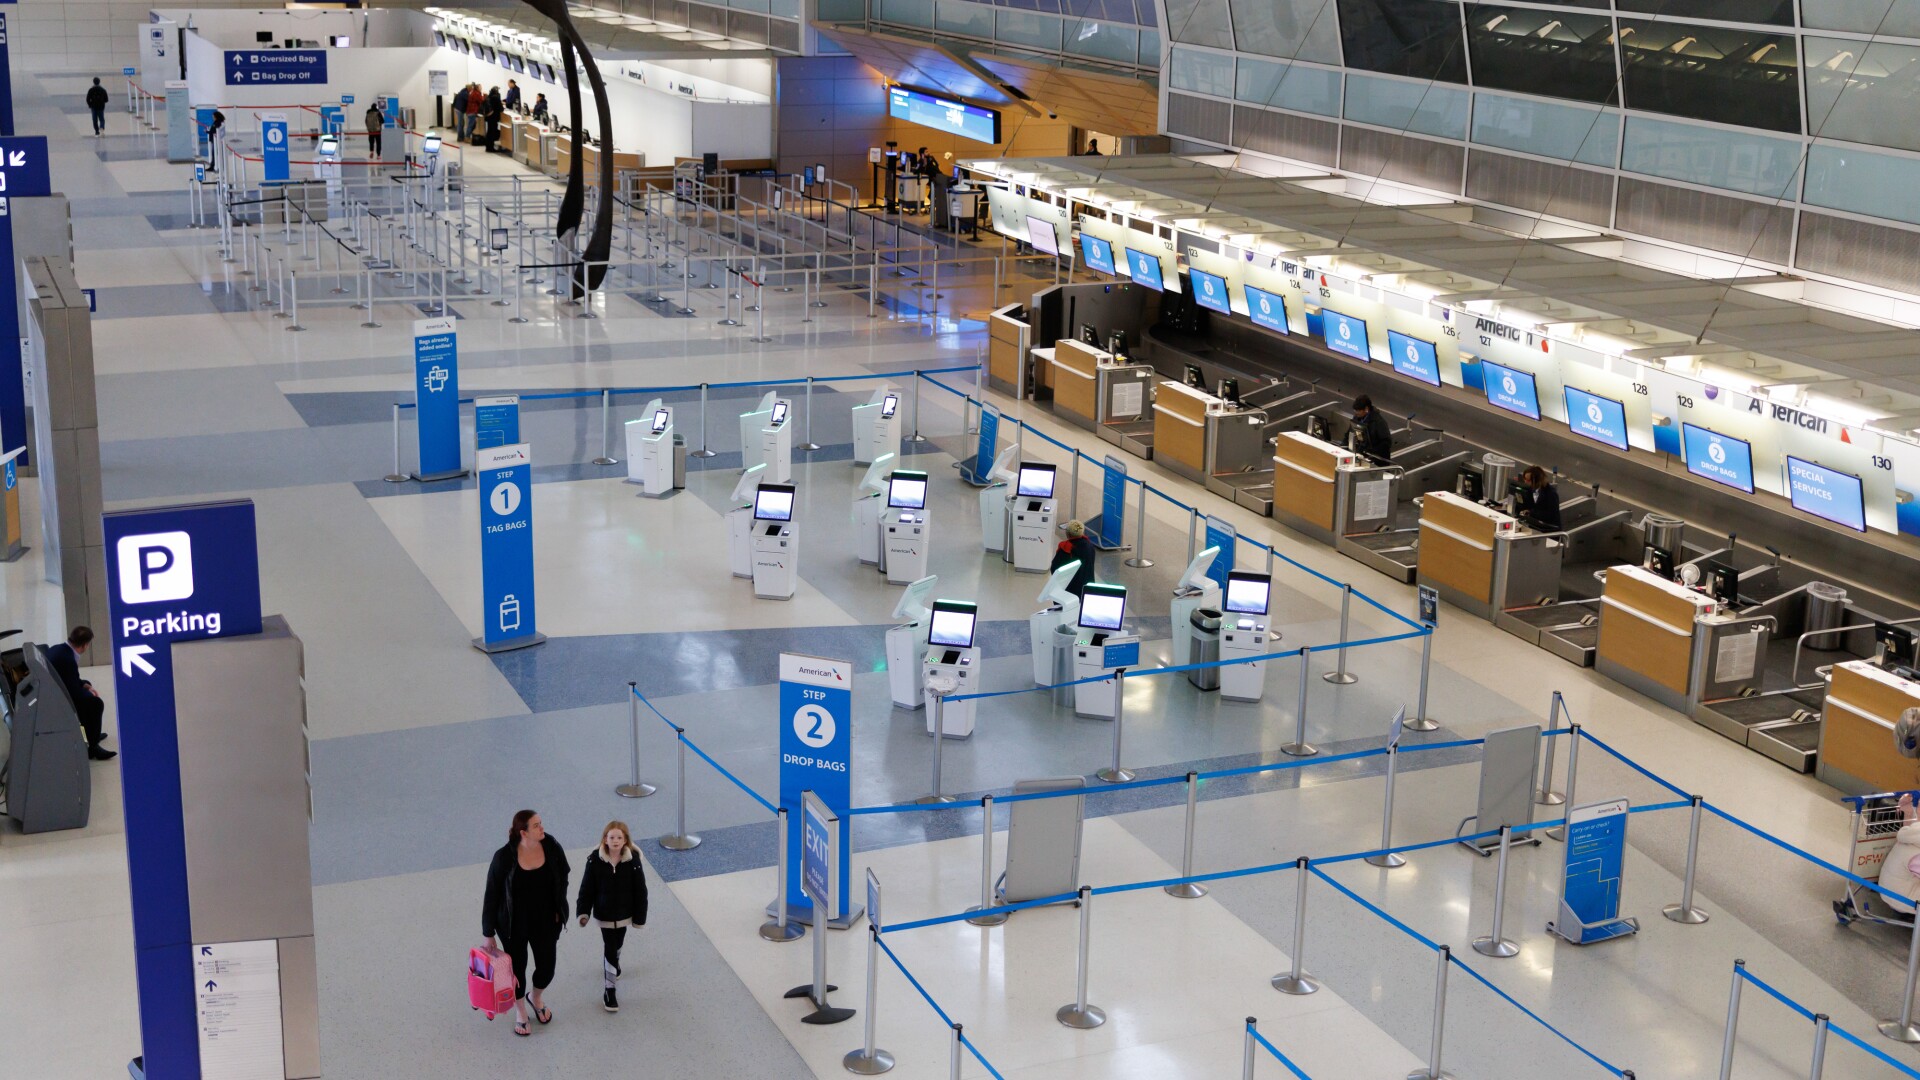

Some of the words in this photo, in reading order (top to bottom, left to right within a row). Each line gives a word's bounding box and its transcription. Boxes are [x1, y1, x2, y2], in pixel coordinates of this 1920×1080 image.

[298, 55, 317, 64] Bags
[262, 72, 276, 81] Bag
[279, 72, 296, 80] Drop
[272, 132, 276, 141] 1
[1058, 209, 1066, 218] 120
[1164, 242, 1174, 251] 122
[1188, 248, 1198, 258] 123
[1270, 258, 1314, 280] Amerian
[1290, 279, 1300, 289] 124
[1319, 287, 1330, 298] 125
[1342, 326, 1348, 337] 2
[1442, 325, 1456, 337] 126
[1475, 318, 1532, 346] Americn
[1480, 335, 1491, 347] 127
[1410, 348, 1416, 360] 2
[1402, 362, 1415, 370] DROP
[1416, 366, 1428, 375] BAGS
[1506, 380, 1513, 392] 2
[1632, 382, 1648, 396] 128
[1498, 393, 1512, 402] DROP
[1512, 398, 1526, 408] BAGS
[1677, 394, 1693, 408] 129
[1591, 407, 1599, 420] 2
[1581, 421, 1597, 431] DROP
[1598, 426, 1613, 437] BAGS
[1710, 435, 1721, 444] STEP
[493, 453, 517, 461] American
[1712, 447, 1721, 461] 2
[1872, 455, 1892, 471] 130
[497, 470, 514, 480] STEP
[1701, 461, 1718, 473] DROP
[1719, 467, 1737, 479] BAGS
[1791, 466, 1825, 485] SPECIAL
[1792, 480, 1832, 501] SERVICES
[500, 488, 509, 509] 1
[487, 524, 503, 534] TAG
[505, 520, 527, 531] BAGS
[138, 545, 174, 590] P
[123, 610, 221, 637] Parking
[799, 666, 832, 678] American
[803, 689, 826, 701] STEP
[807, 711, 823, 739] 2
[784, 754, 814, 767] DROP
[816, 759, 846, 772] BAGS
[806, 823, 828, 867] EXIT
[1858, 853, 1883, 866] DFW
[812, 867, 824, 885] PLEASE
